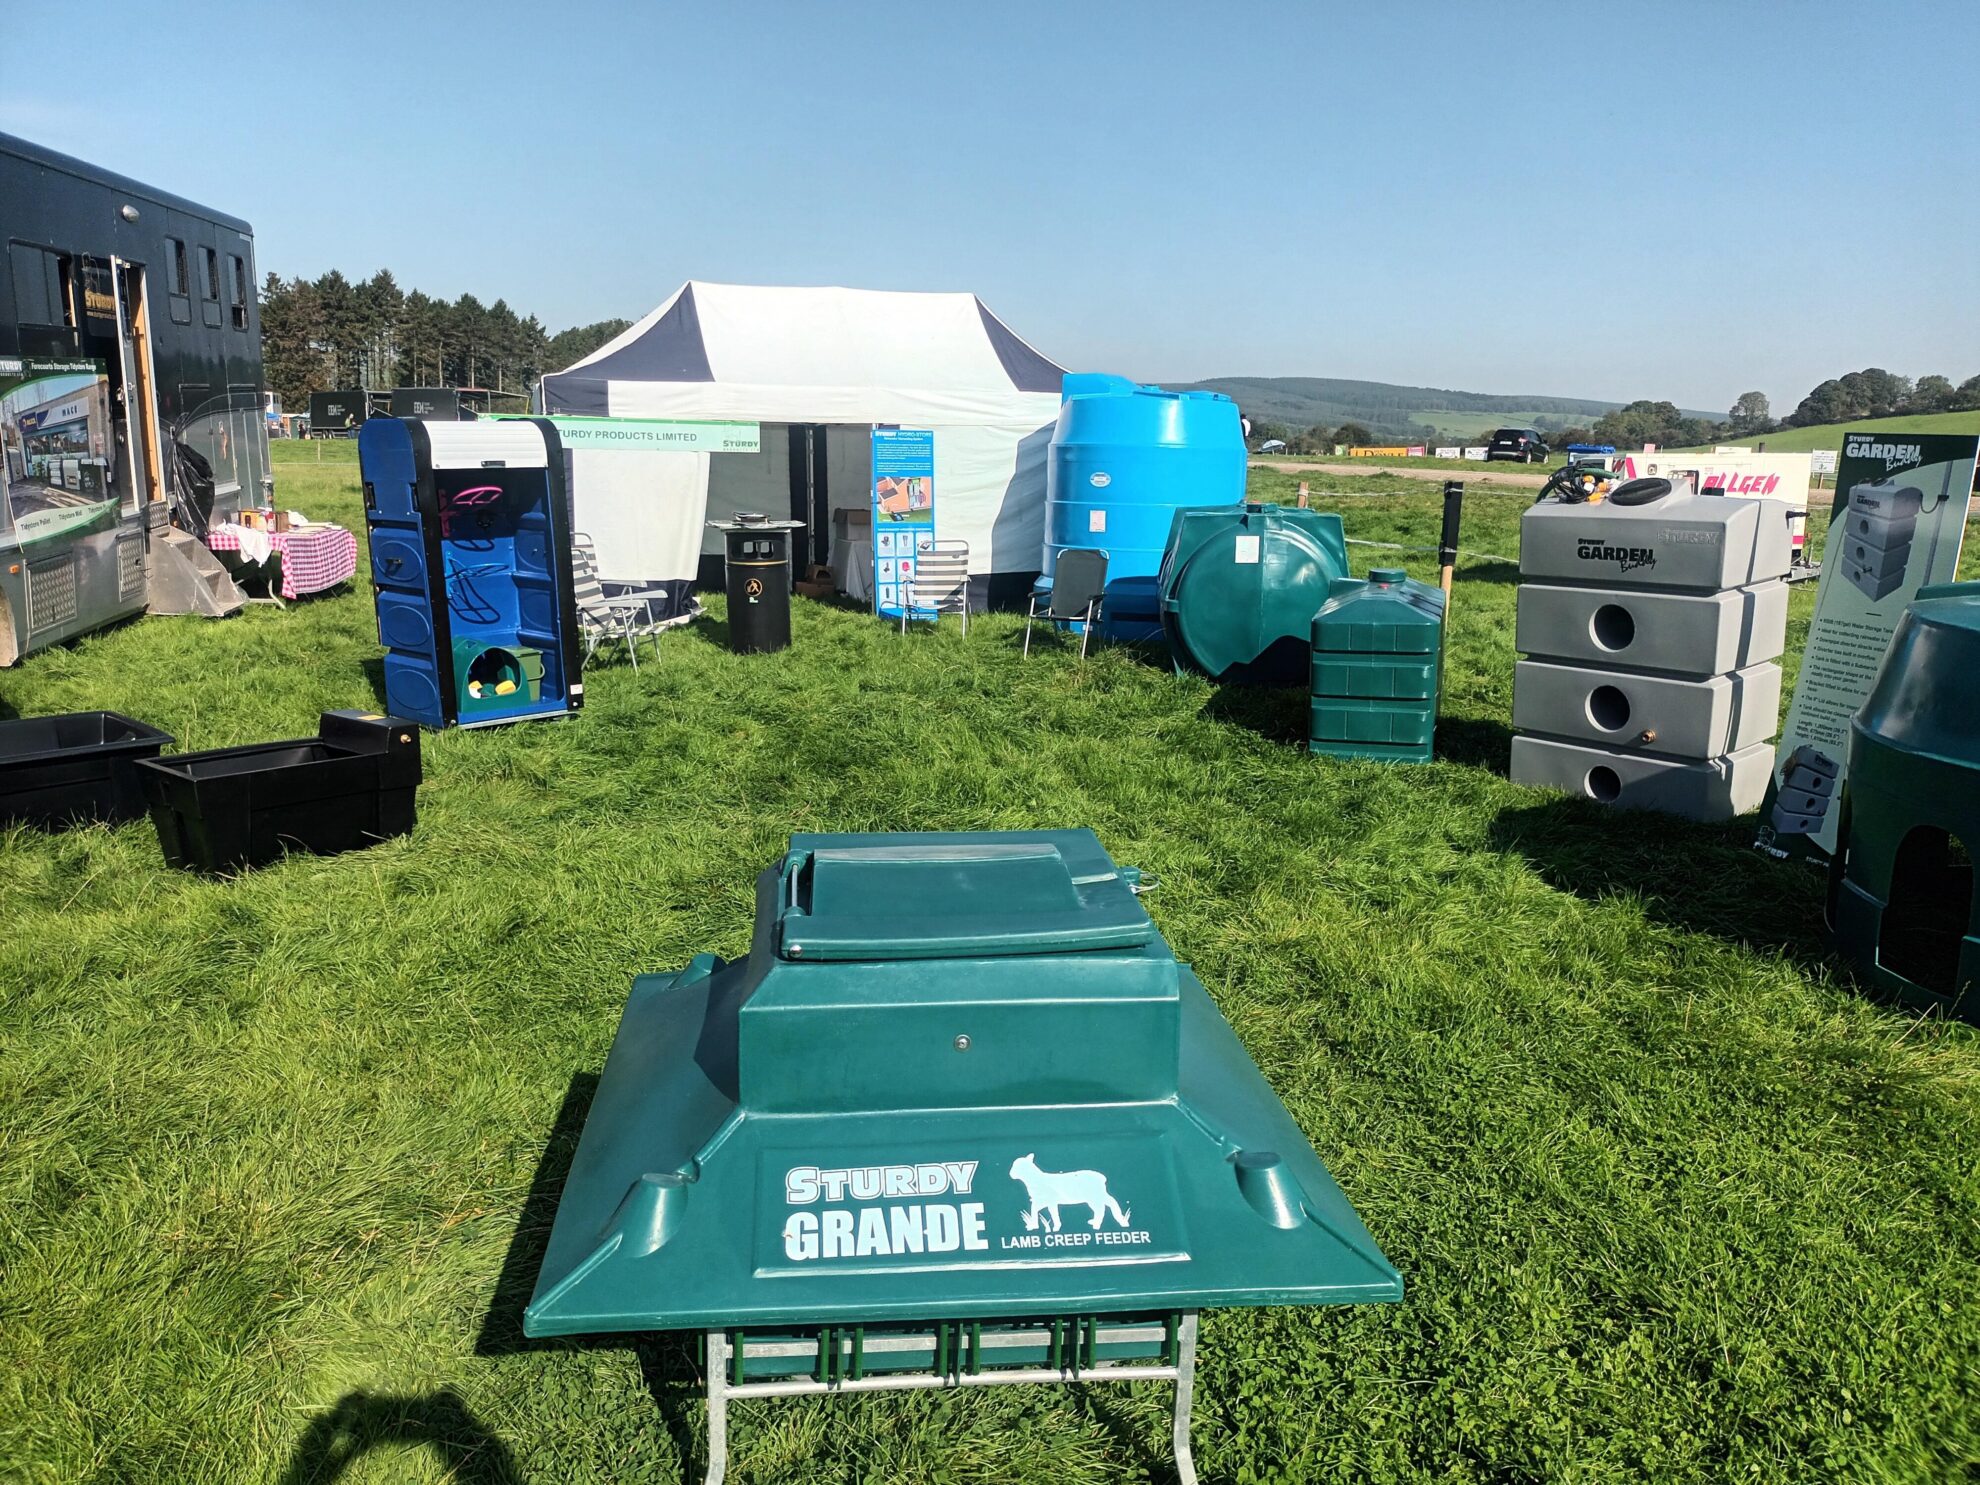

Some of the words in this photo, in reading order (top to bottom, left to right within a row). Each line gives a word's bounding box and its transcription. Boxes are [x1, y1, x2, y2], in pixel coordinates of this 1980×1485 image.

[0, 360, 23, 371] TURDY
[556, 429, 593, 439] TURDY
[594, 430, 654, 441] PRODUCTS
[656, 432, 697, 442] LIMITED
[1848, 435, 1875, 443] STURDY
[1846, 442, 1921, 459] GARDEN
[1885, 450, 1924, 472] Buddy
[1577, 538, 1606, 546] STURDY
[1577, 545, 1654, 562] GARDEN
[1619, 553, 1658, 573] Buddy
[785, 1160, 979, 1205] STURDY
[784, 1202, 989, 1261] GRANDE
[1001, 1233, 1041, 1249] LAMB
[1044, 1233, 1092, 1248] CREEP
[1095, 1231, 1151, 1245] FEEDER
